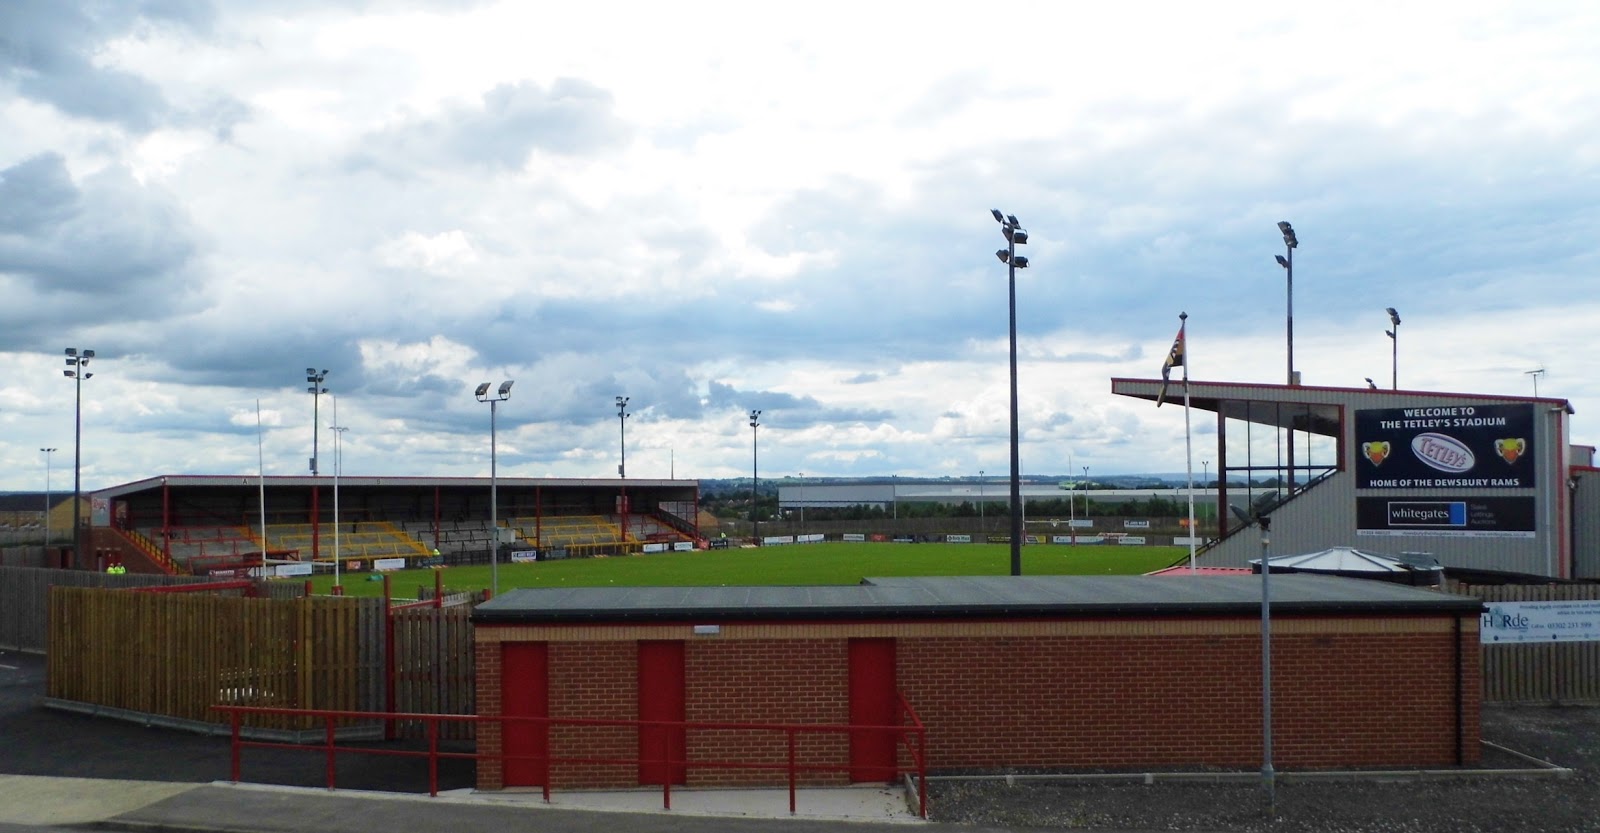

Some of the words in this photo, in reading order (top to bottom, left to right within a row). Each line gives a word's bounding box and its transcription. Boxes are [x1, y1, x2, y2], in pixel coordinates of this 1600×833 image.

[1403, 407, 1457, 417] WELCOME
[1461, 406, 1475, 416] TO
[1380, 420, 1401, 429] THE
[1403, 418, 1451, 428] TETLEY'S
[1453, 417, 1506, 427] STADIUM
[1370, 479, 1397, 487] HOME
[1399, 479, 1412, 487] OF
[1434, 478, 1489, 487] DEWSBURY
[1491, 478, 1520, 486] RAMS
[1392, 508, 1449, 521] whitegates
